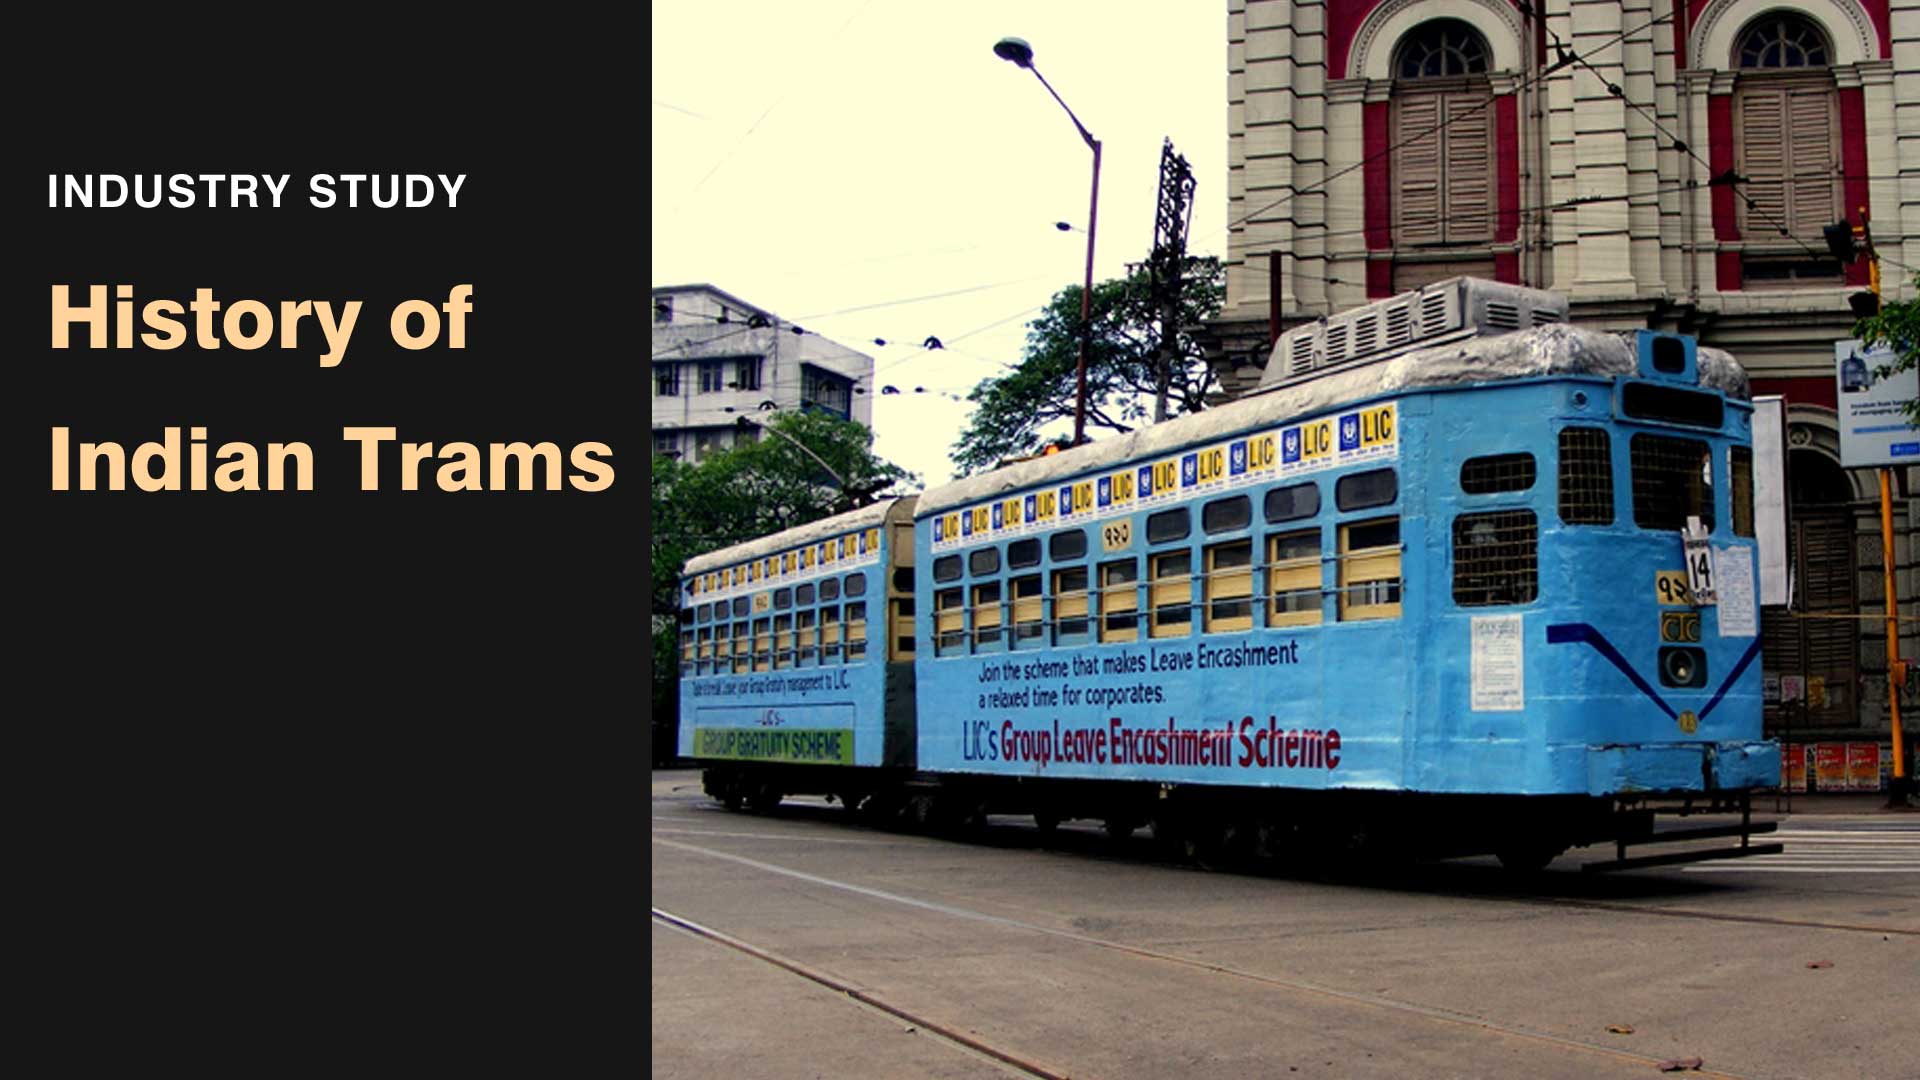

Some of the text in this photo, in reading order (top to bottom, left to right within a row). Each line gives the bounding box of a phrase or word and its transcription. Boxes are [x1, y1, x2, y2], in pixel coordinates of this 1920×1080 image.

[1304, 423, 1329, 456] LIC
[1363, 409, 1391, 442] LIC
[1200, 450, 1221, 480] LIC
[1249, 437, 1273, 468] LIC
[1113, 473, 1131, 501] LIC
[1155, 462, 1175, 490] LIC
[1074, 483, 1092, 509] LIC
[1690, 553, 1711, 588] 14
[1664, 612, 1700, 641] CTC
[978, 639, 1299, 683] Join the scheme that makes Leave Encashment
[978, 682, 1167, 710] a relaxed time for corporates.
[792, 731, 842, 760] SCHEME
[963, 715, 1342, 769] LIC's Group Leave Encashment Scheme
